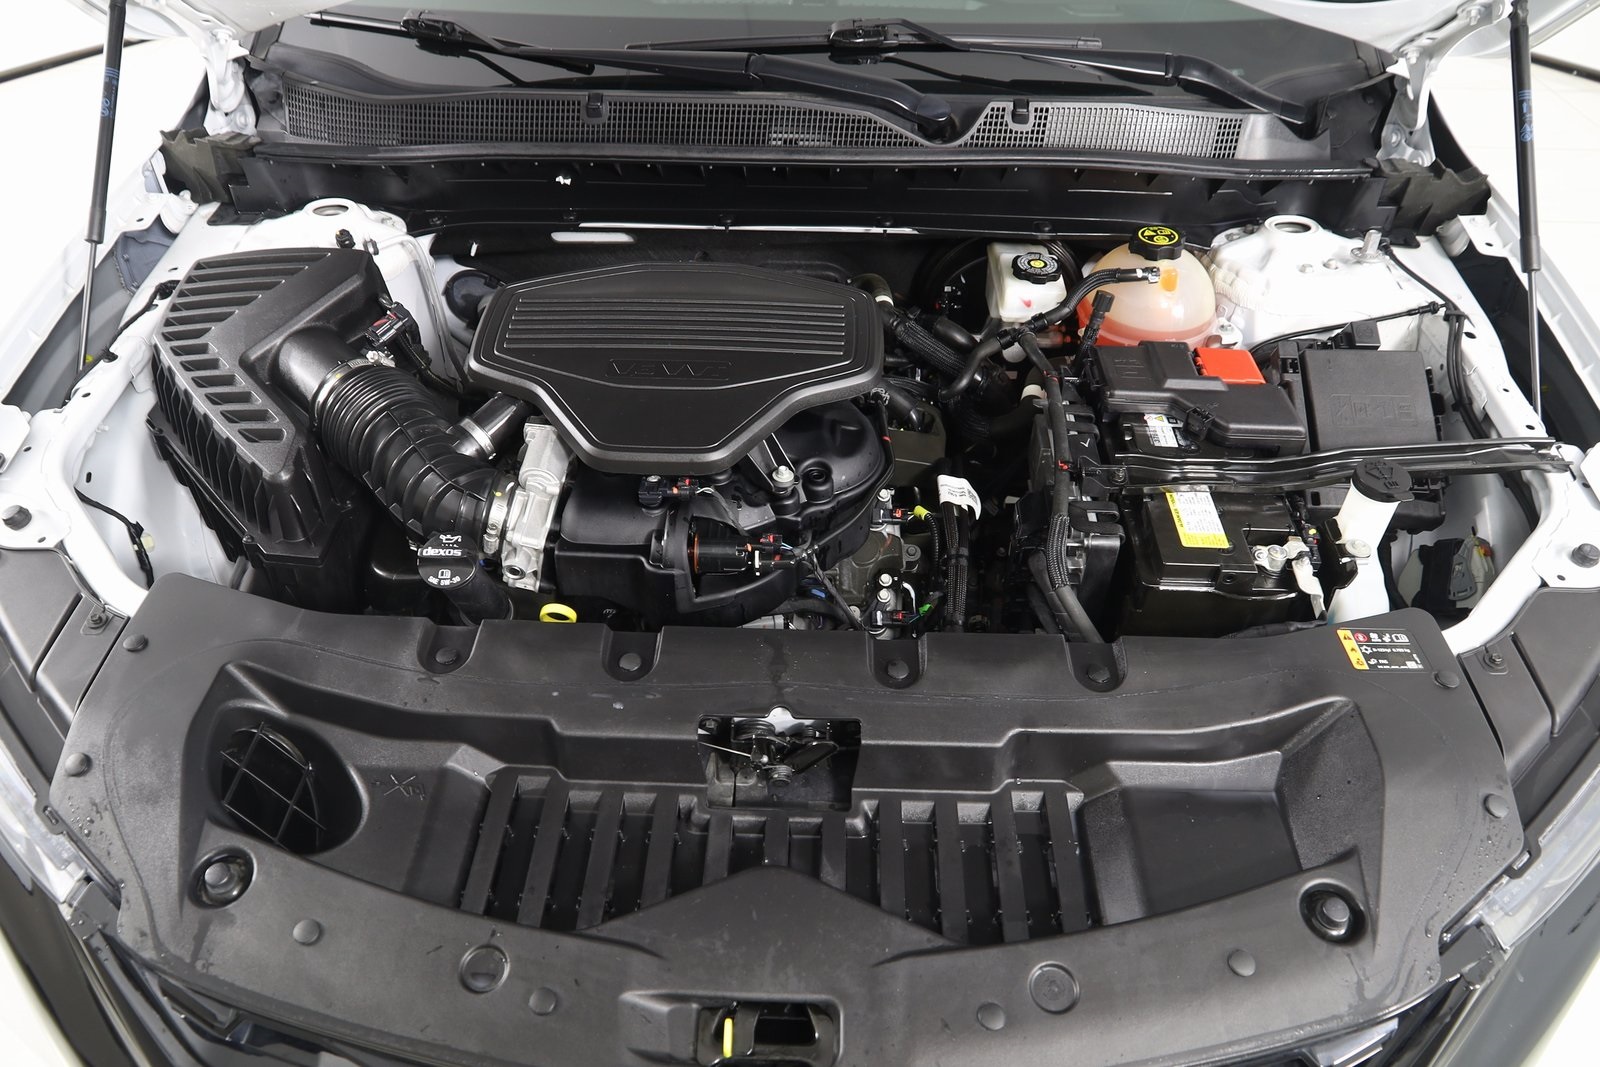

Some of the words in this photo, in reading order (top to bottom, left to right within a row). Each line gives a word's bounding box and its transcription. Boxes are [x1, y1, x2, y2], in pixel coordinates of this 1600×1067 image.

[422, 546, 462, 557] dexos
[427, 575, 440, 585] SAE
[440, 575, 461, 586] 5W-30
